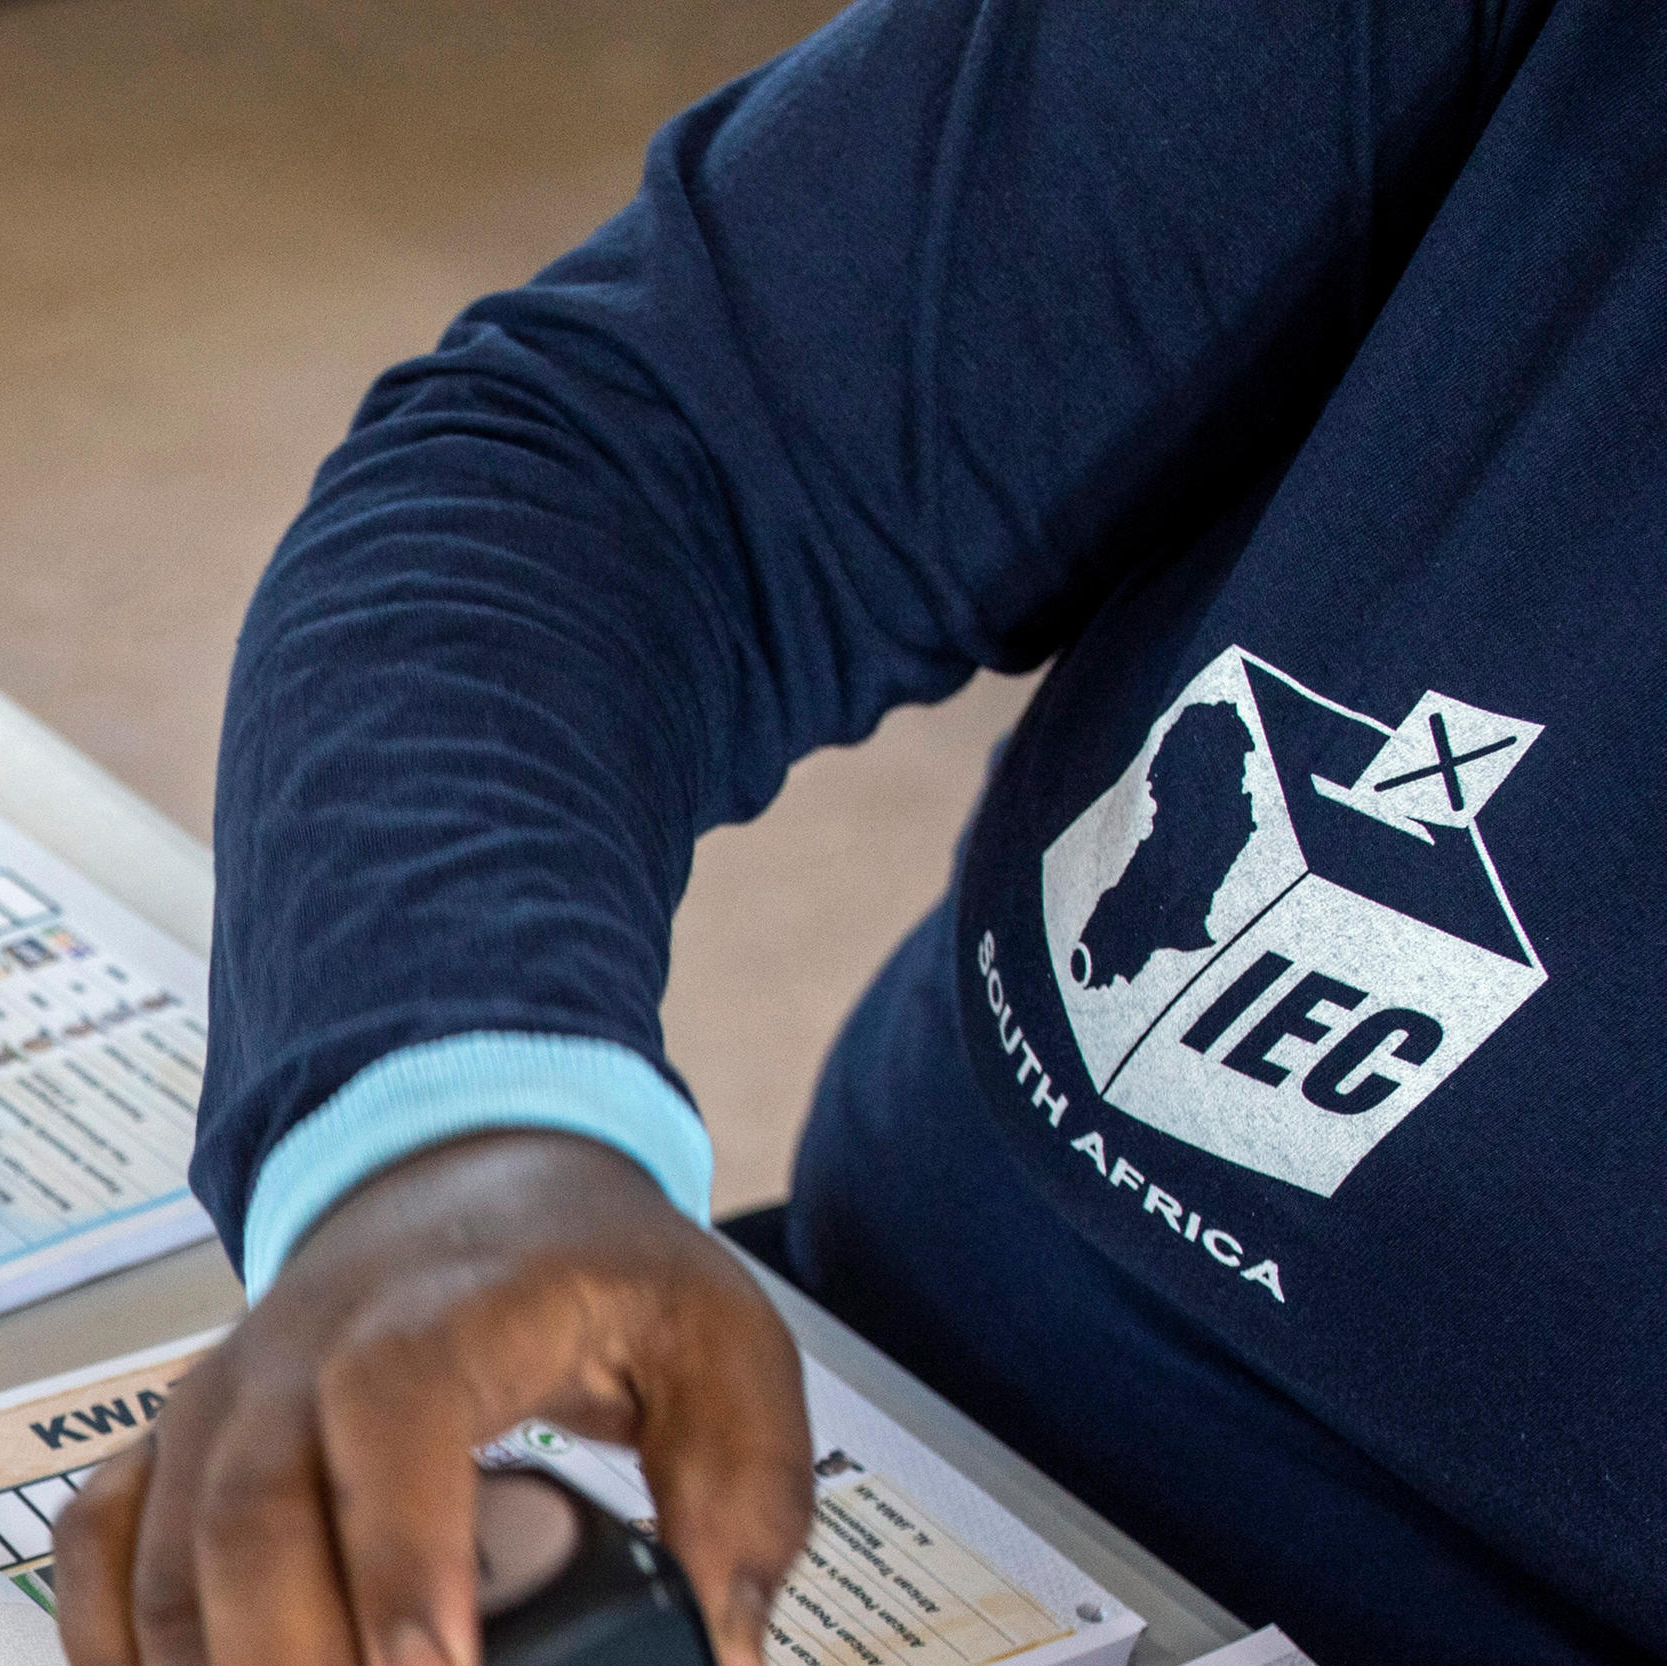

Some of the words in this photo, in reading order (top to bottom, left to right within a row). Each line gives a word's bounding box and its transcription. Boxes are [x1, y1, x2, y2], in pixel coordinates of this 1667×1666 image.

[977, 929, 1068, 1127] SOUTH
[1071, 1130, 1287, 1303] AFRICA
[1181, 951, 1444, 1116] IEC
